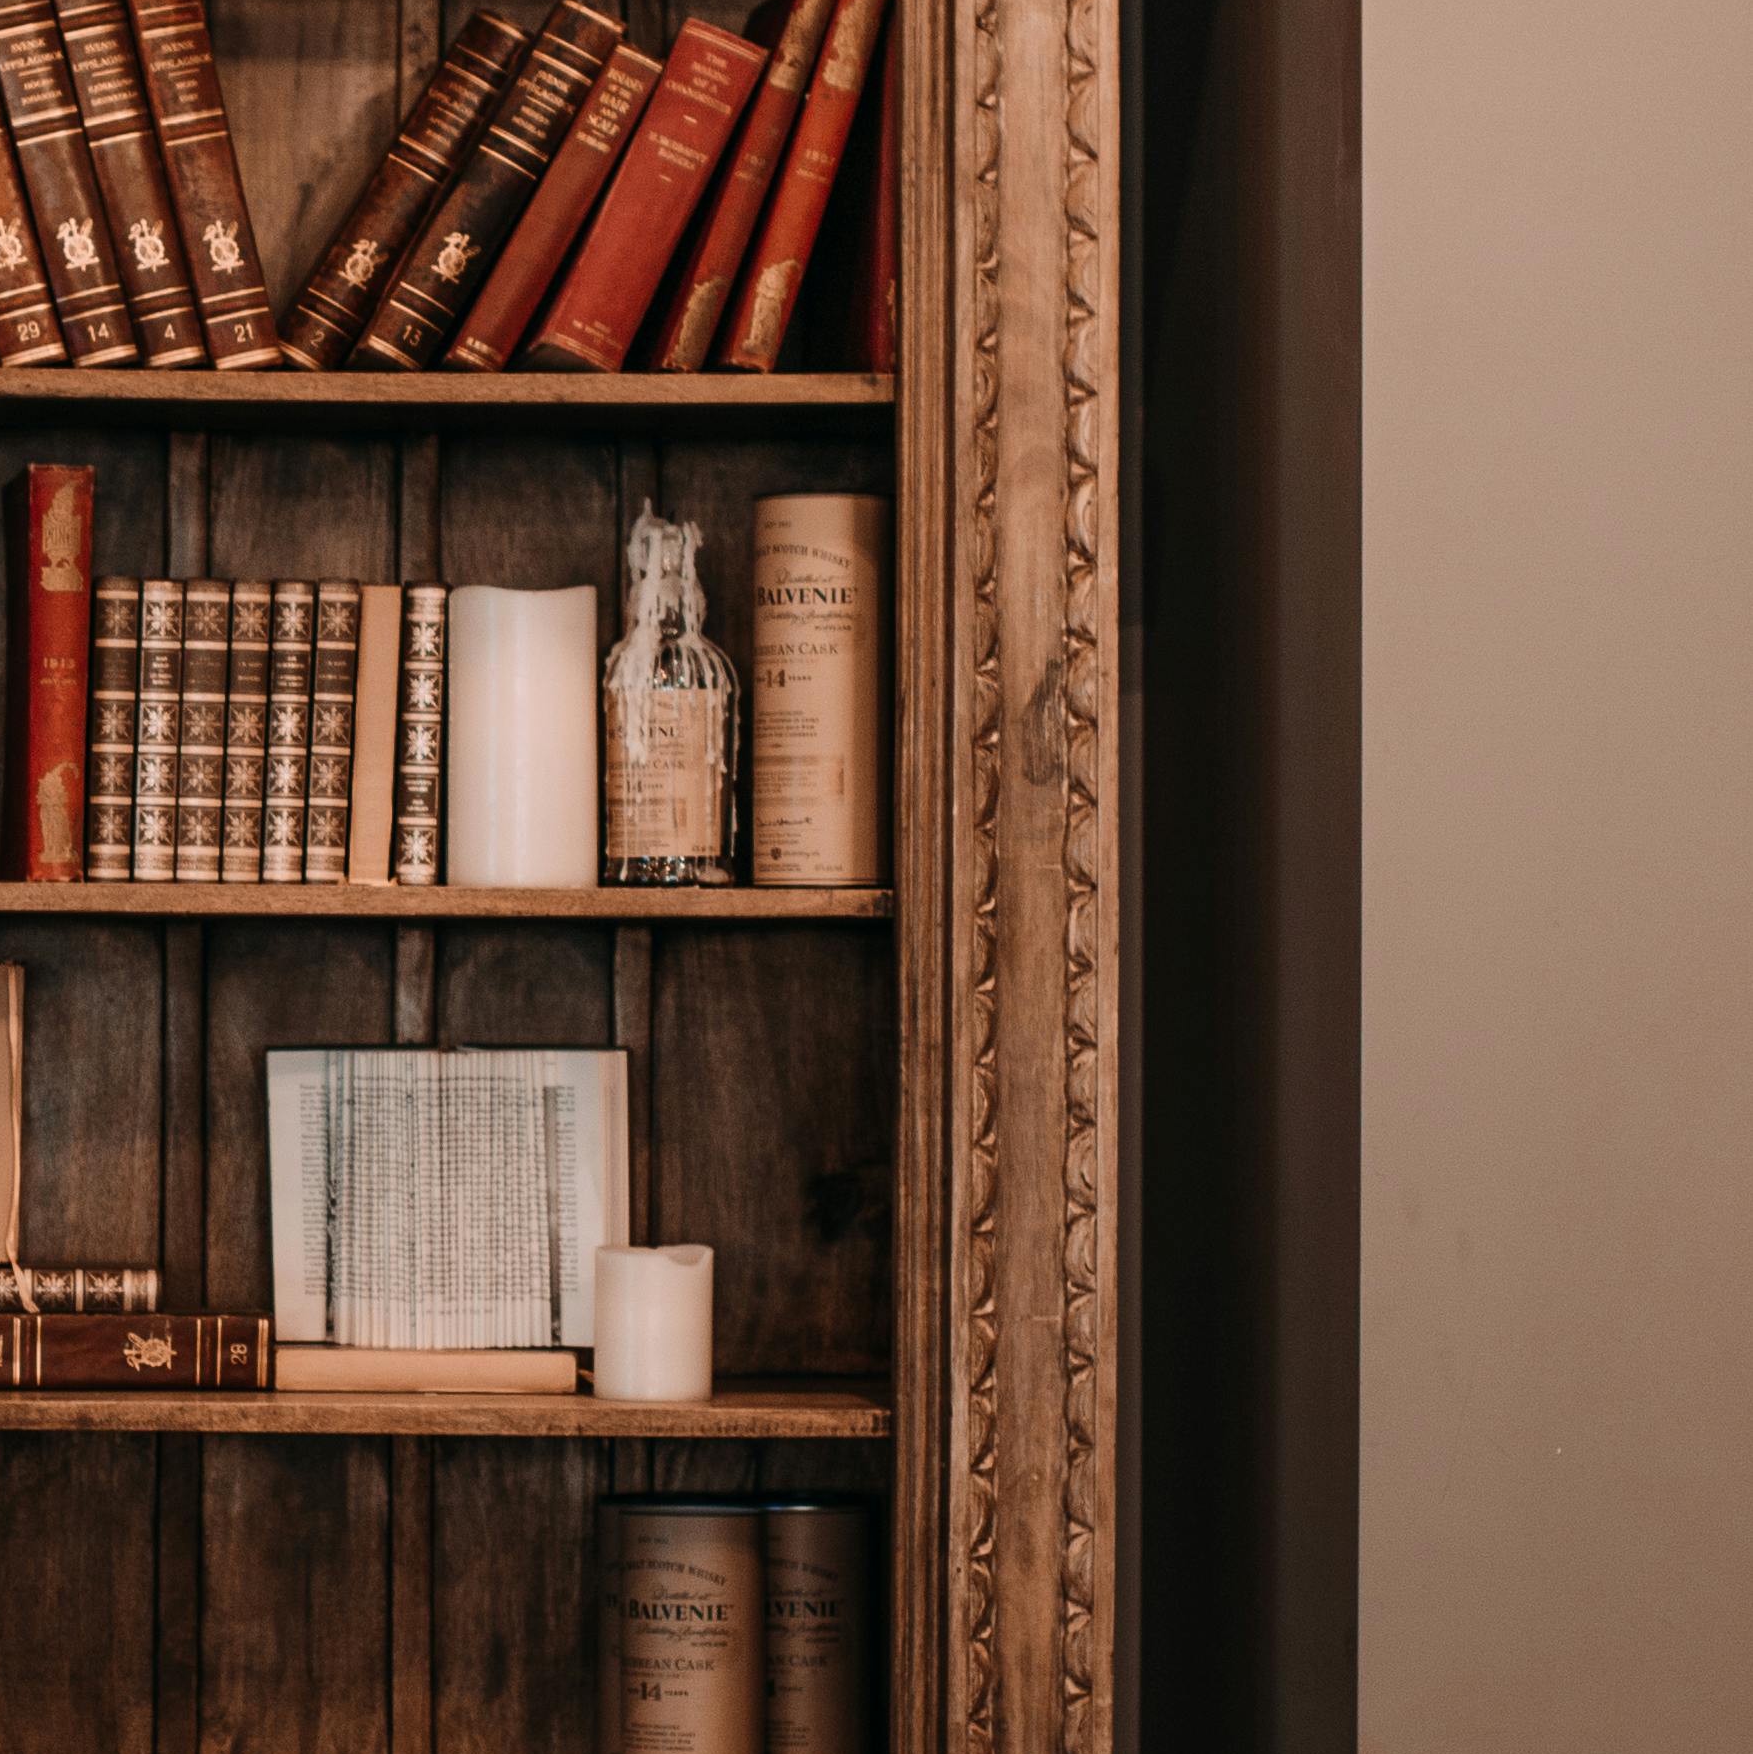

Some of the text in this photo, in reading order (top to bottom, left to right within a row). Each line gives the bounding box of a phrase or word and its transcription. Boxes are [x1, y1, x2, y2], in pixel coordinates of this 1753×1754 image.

[17, 321, 41, 342] 29
[87, 323, 110, 343] 14
[164, 324, 176, 341] 4
[234, 324, 255, 343] 21
[310, 330, 325, 348] 2
[757, 586, 853, 606] BALVENIE
[797, 642, 839, 656] CASK
[765, 668, 786, 688] 14
[230, 1342, 248, 1366] 28
[629, 1598, 729, 1622] BALVENIE
[674, 1657, 716, 1671] CASK
[640, 1681, 662, 1701] 14
